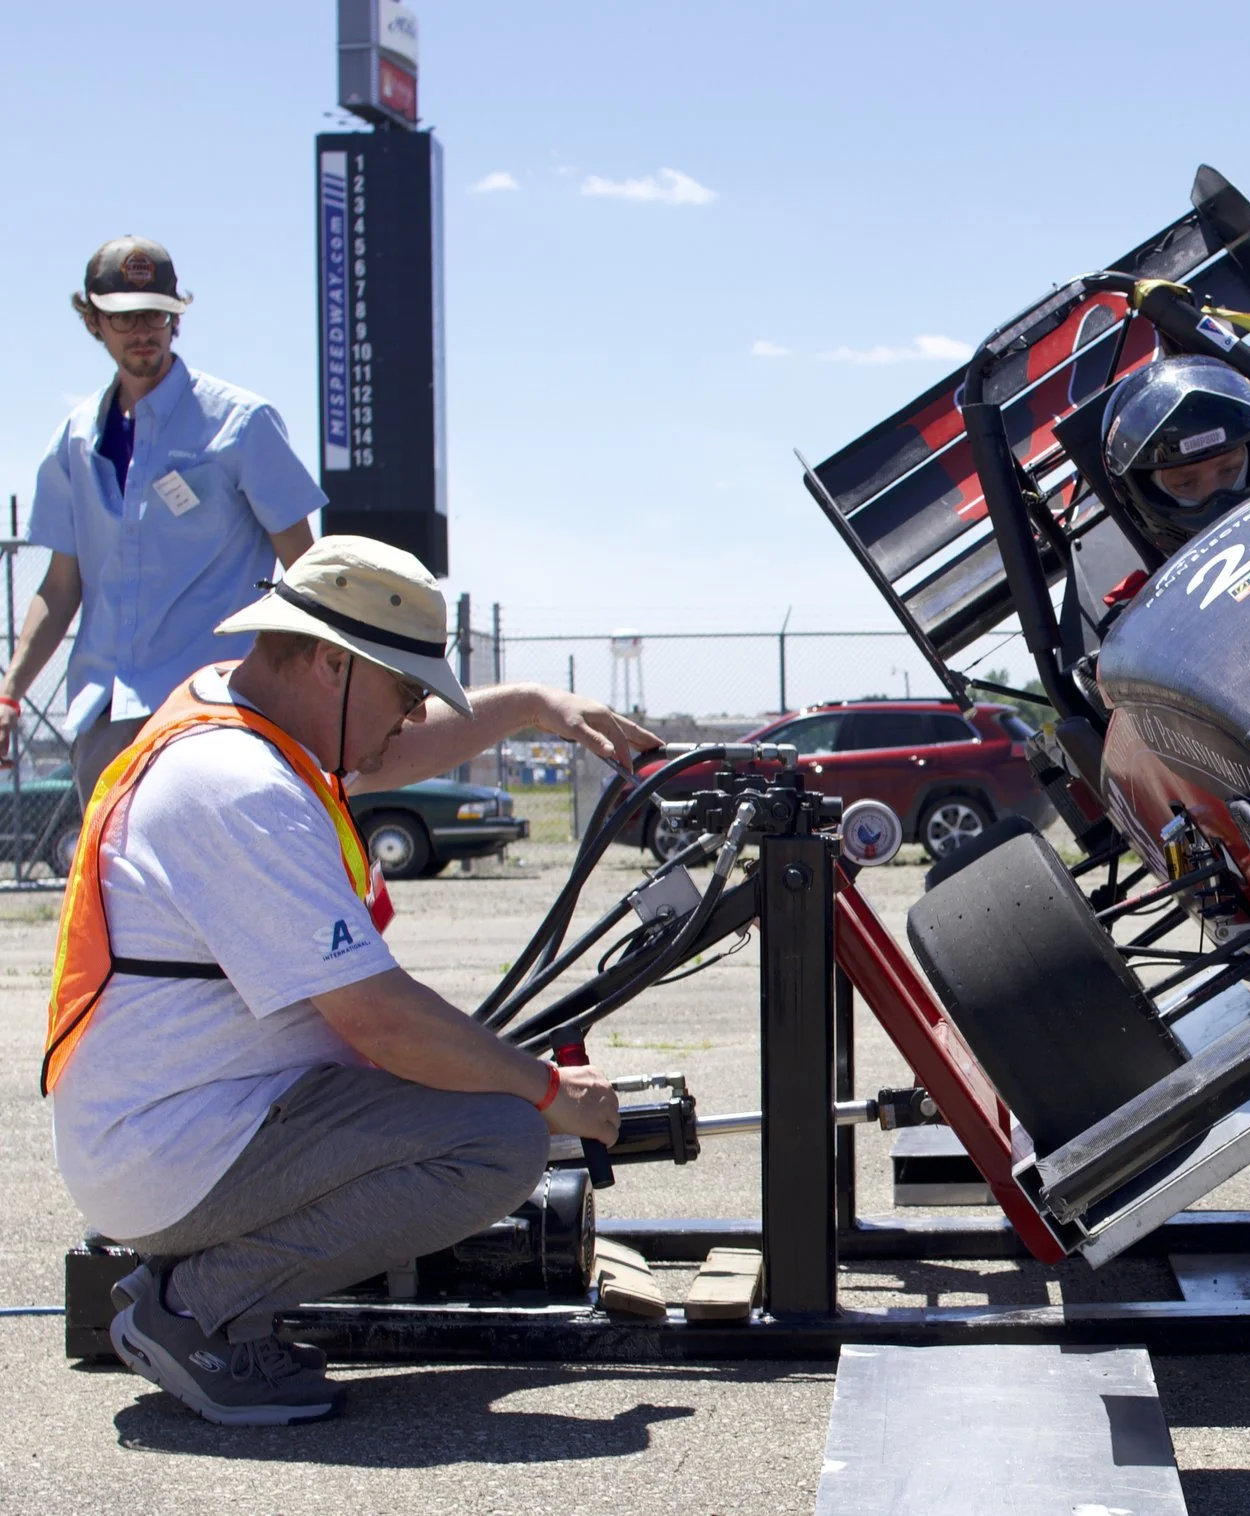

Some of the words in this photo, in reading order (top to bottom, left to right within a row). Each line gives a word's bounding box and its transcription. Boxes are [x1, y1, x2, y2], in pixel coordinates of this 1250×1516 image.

[355, 154, 365, 173] 1
[353, 174, 365, 193] 2
[353, 195, 366, 215] 3
[353, 216, 366, 235] 4
[354, 237, 366, 256] 5
[354, 258, 366, 278] 6
[355, 279, 366, 298] 7
[355, 300, 367, 319] 8
[355, 322, 367, 340] 9
[352, 342, 373, 361] 10
[352, 364, 372, 382] 11
[352, 385, 373, 403] 12
[352, 406, 373, 425] 13
[352, 427, 373, 445] 14
[353, 447, 374, 467] 15
